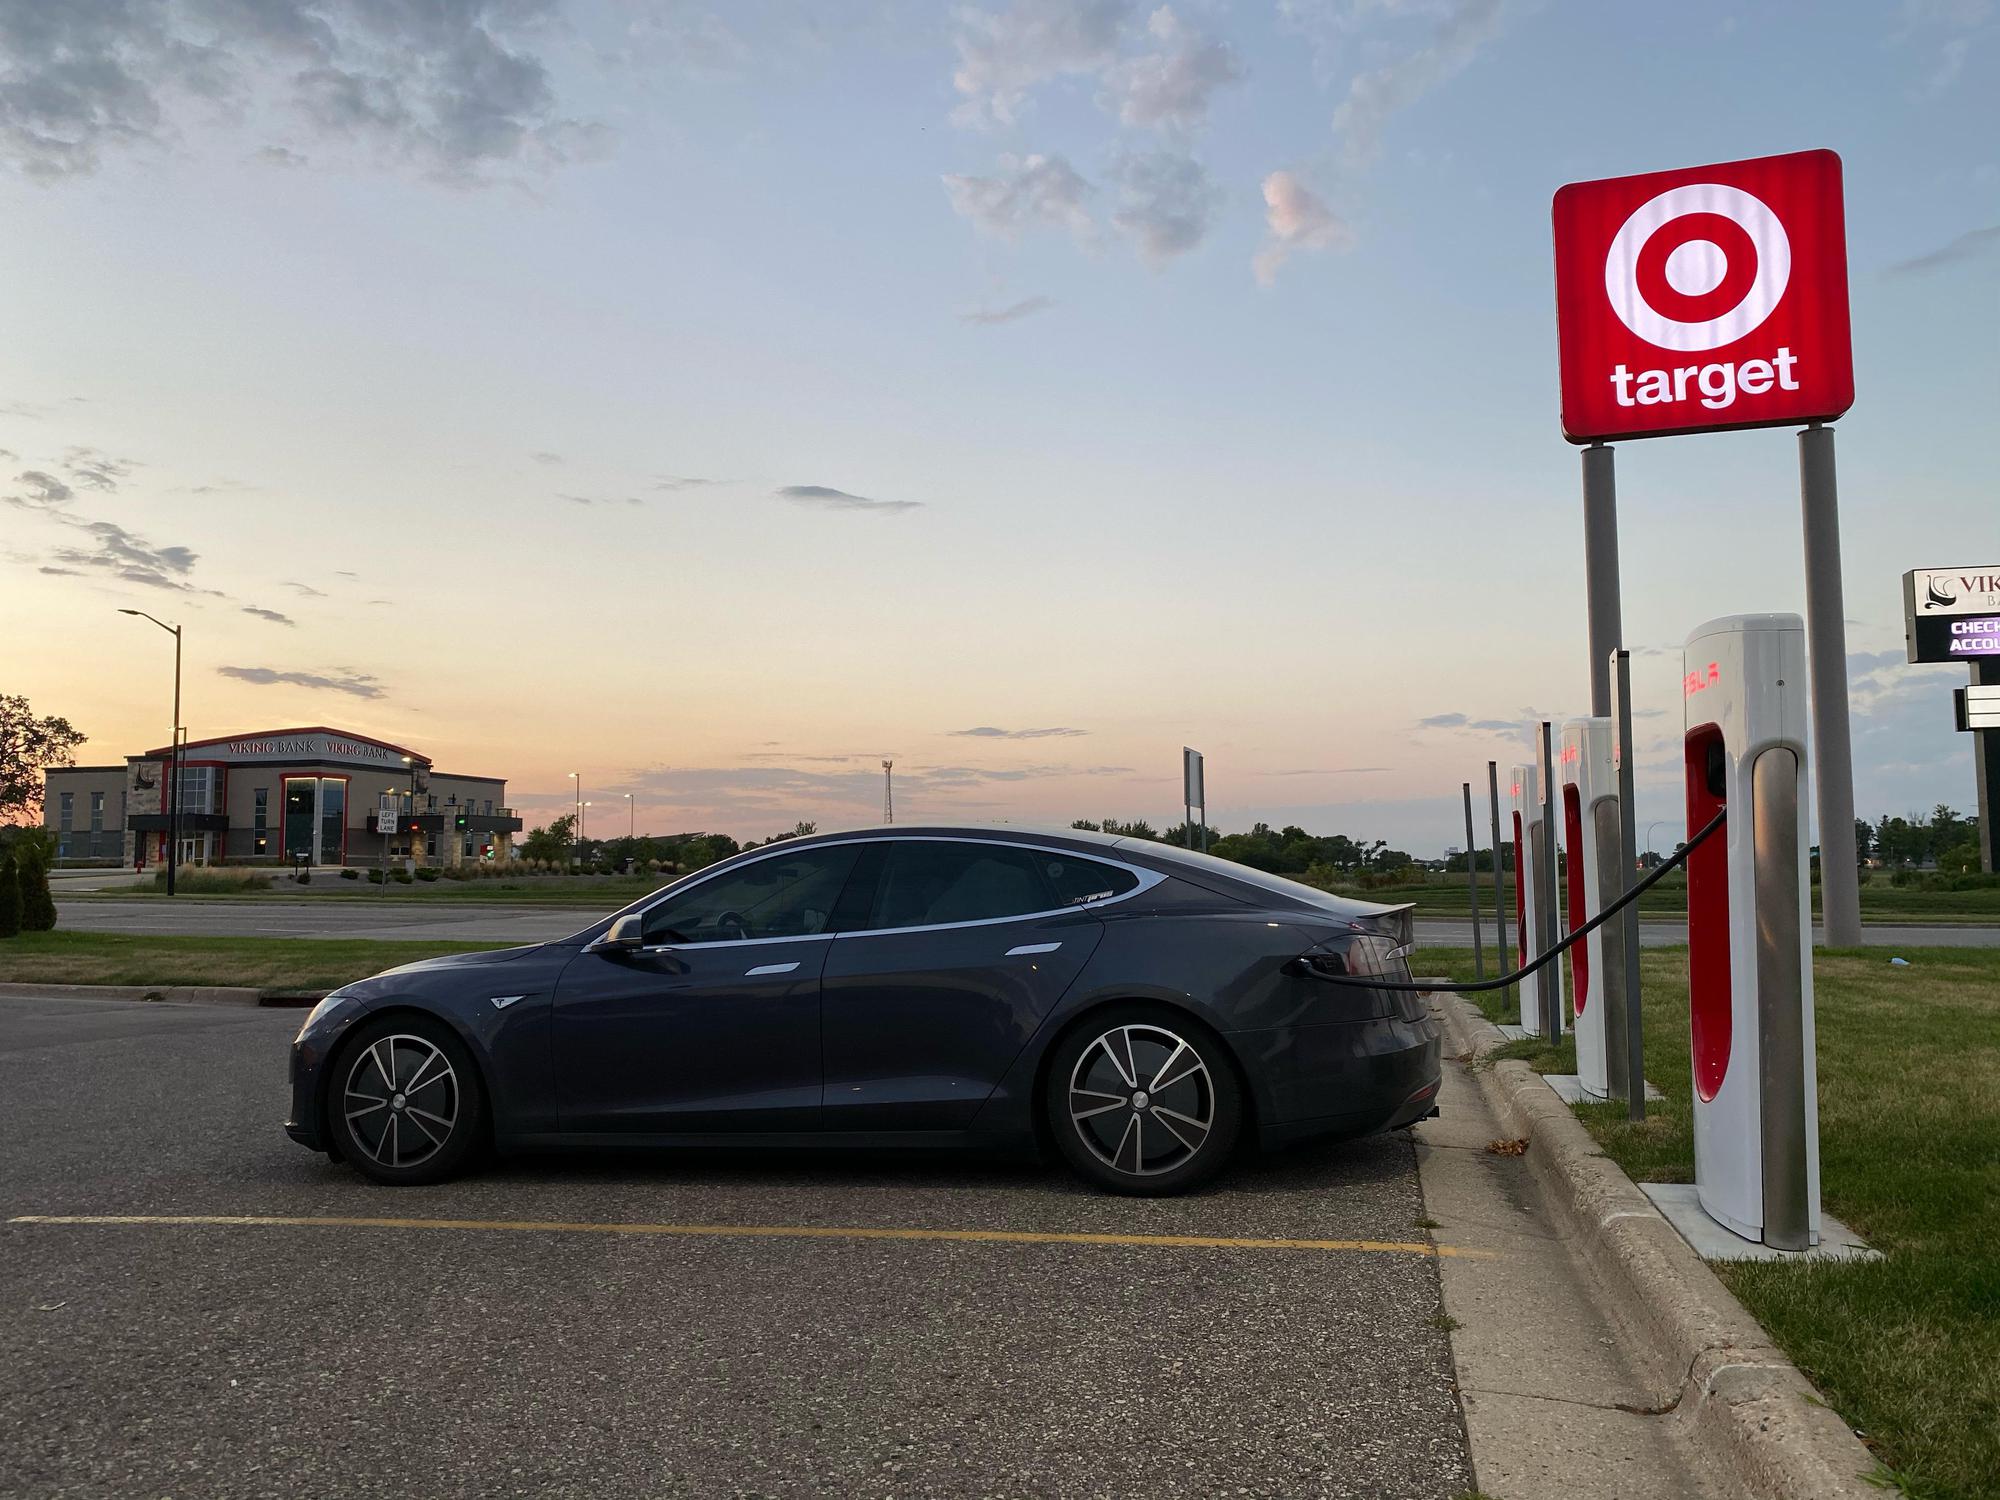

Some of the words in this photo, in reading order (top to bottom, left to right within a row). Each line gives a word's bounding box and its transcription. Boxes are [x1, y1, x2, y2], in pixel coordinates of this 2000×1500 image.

[1610, 347, 1799, 410] target
[228, 742, 275, 754] VIKING
[278, 740, 316, 753] BANK
[325, 741, 360, 756] VIKING
[362, 747, 389, 760] BANK
